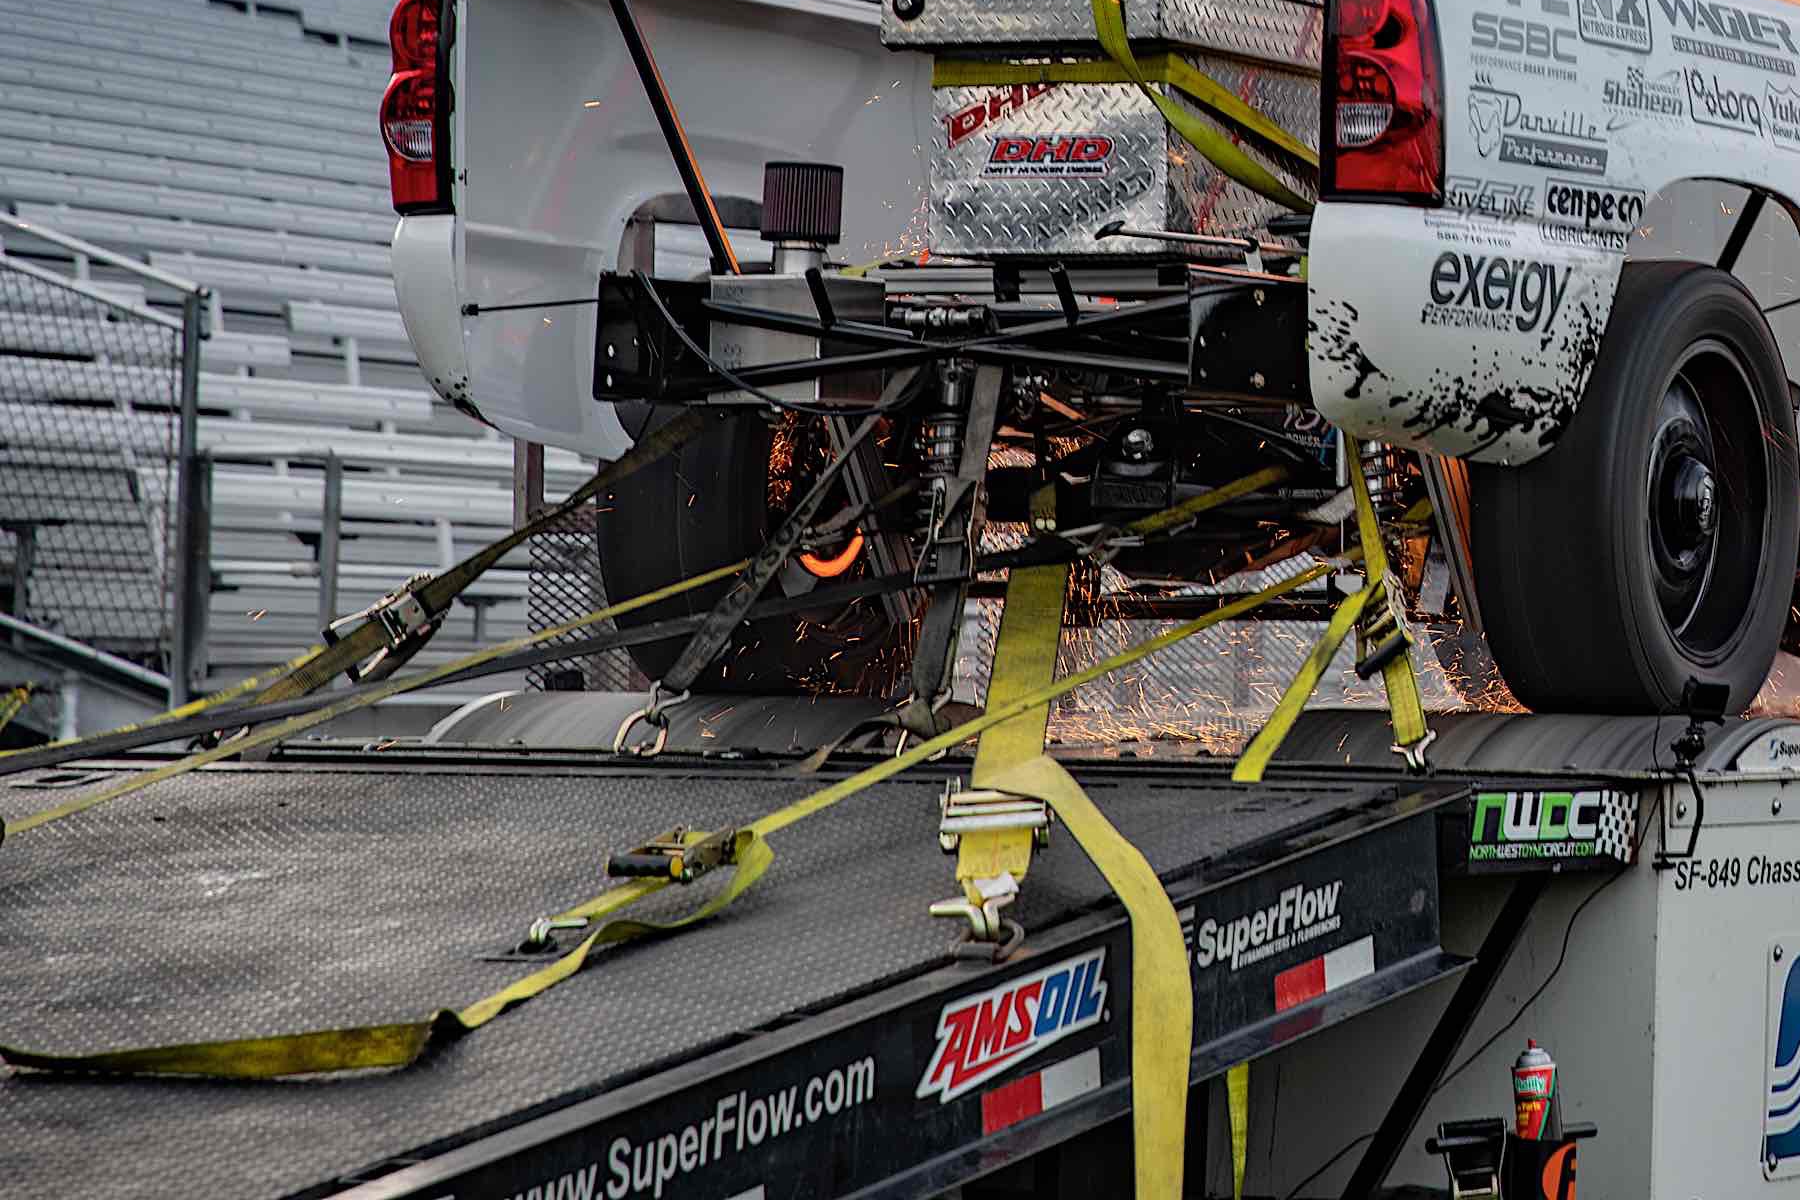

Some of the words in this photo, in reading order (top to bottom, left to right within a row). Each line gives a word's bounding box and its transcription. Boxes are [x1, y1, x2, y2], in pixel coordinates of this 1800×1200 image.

[1472, 11, 1577, 63] SSBC
[942, 83, 1058, 149] DH
[1500, 87, 1607, 142] Danville
[1602, 79, 1683, 117] Shaheen
[991, 136, 1115, 163] DHD
[1442, 190, 1537, 218] RIVELINE
[1543, 223, 1625, 250] LUBRICANTS
[1430, 251, 1572, 333] exergy
[1674, 856, 1740, 891] SF-849
[1197, 879, 1344, 972] SuperFlow
[925, 955, 1104, 1093] AMSOIL
[504, 1055, 874, 1200] w.SuperFlow.com
